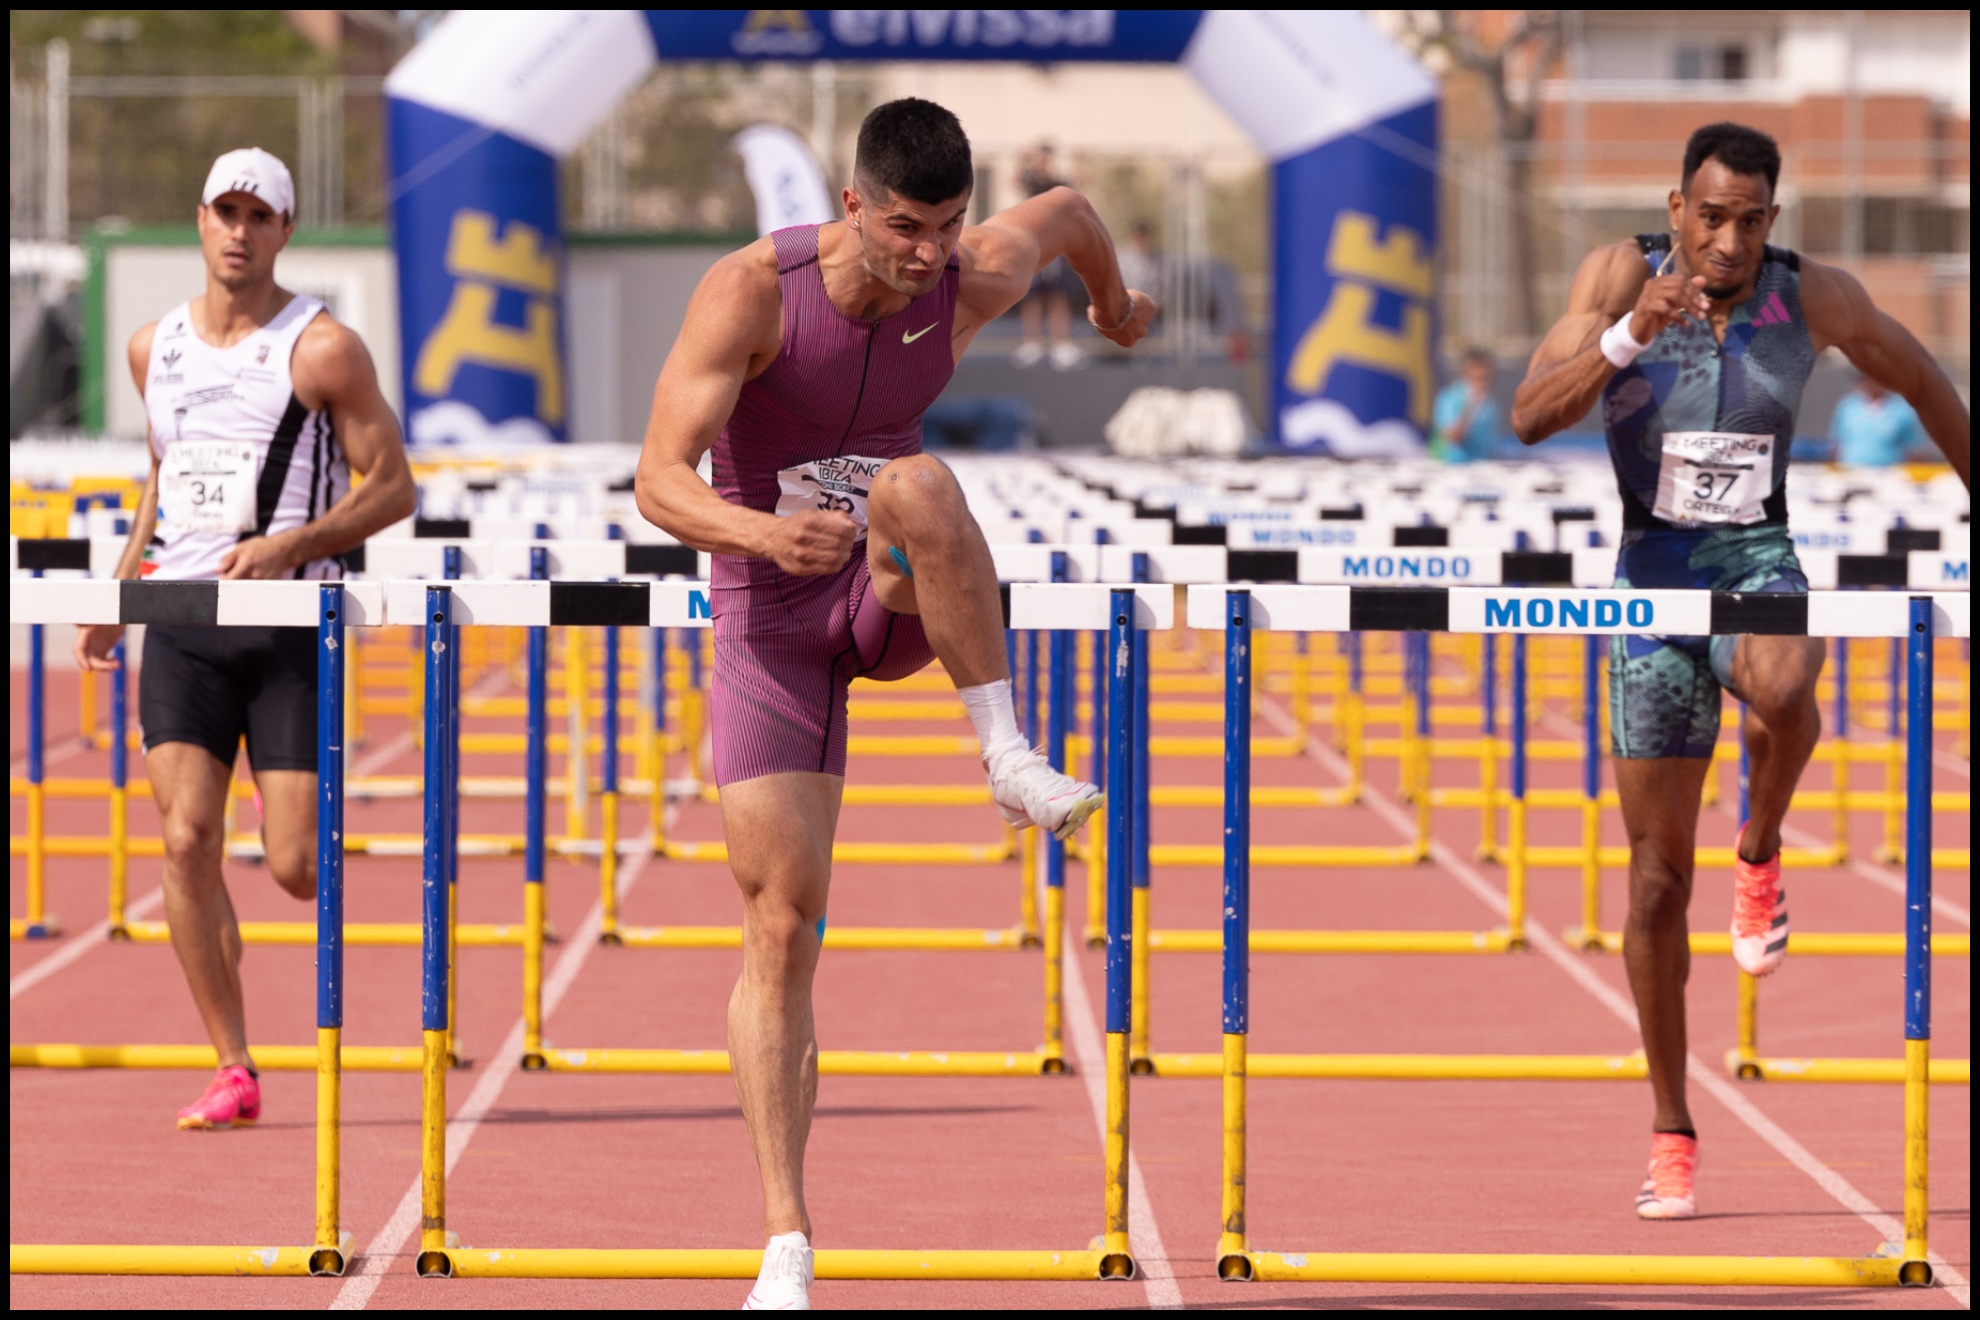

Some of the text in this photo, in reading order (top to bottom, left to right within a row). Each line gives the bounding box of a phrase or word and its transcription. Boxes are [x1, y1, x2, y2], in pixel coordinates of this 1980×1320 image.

[812, 458, 882, 480] EETING
[819, 467, 852, 484] IBIZA
[191, 480, 224, 506] 34
[1693, 472, 1740, 501] 37
[1342, 557, 1471, 578] MONDO
[1484, 598, 1654, 628] MONDO
